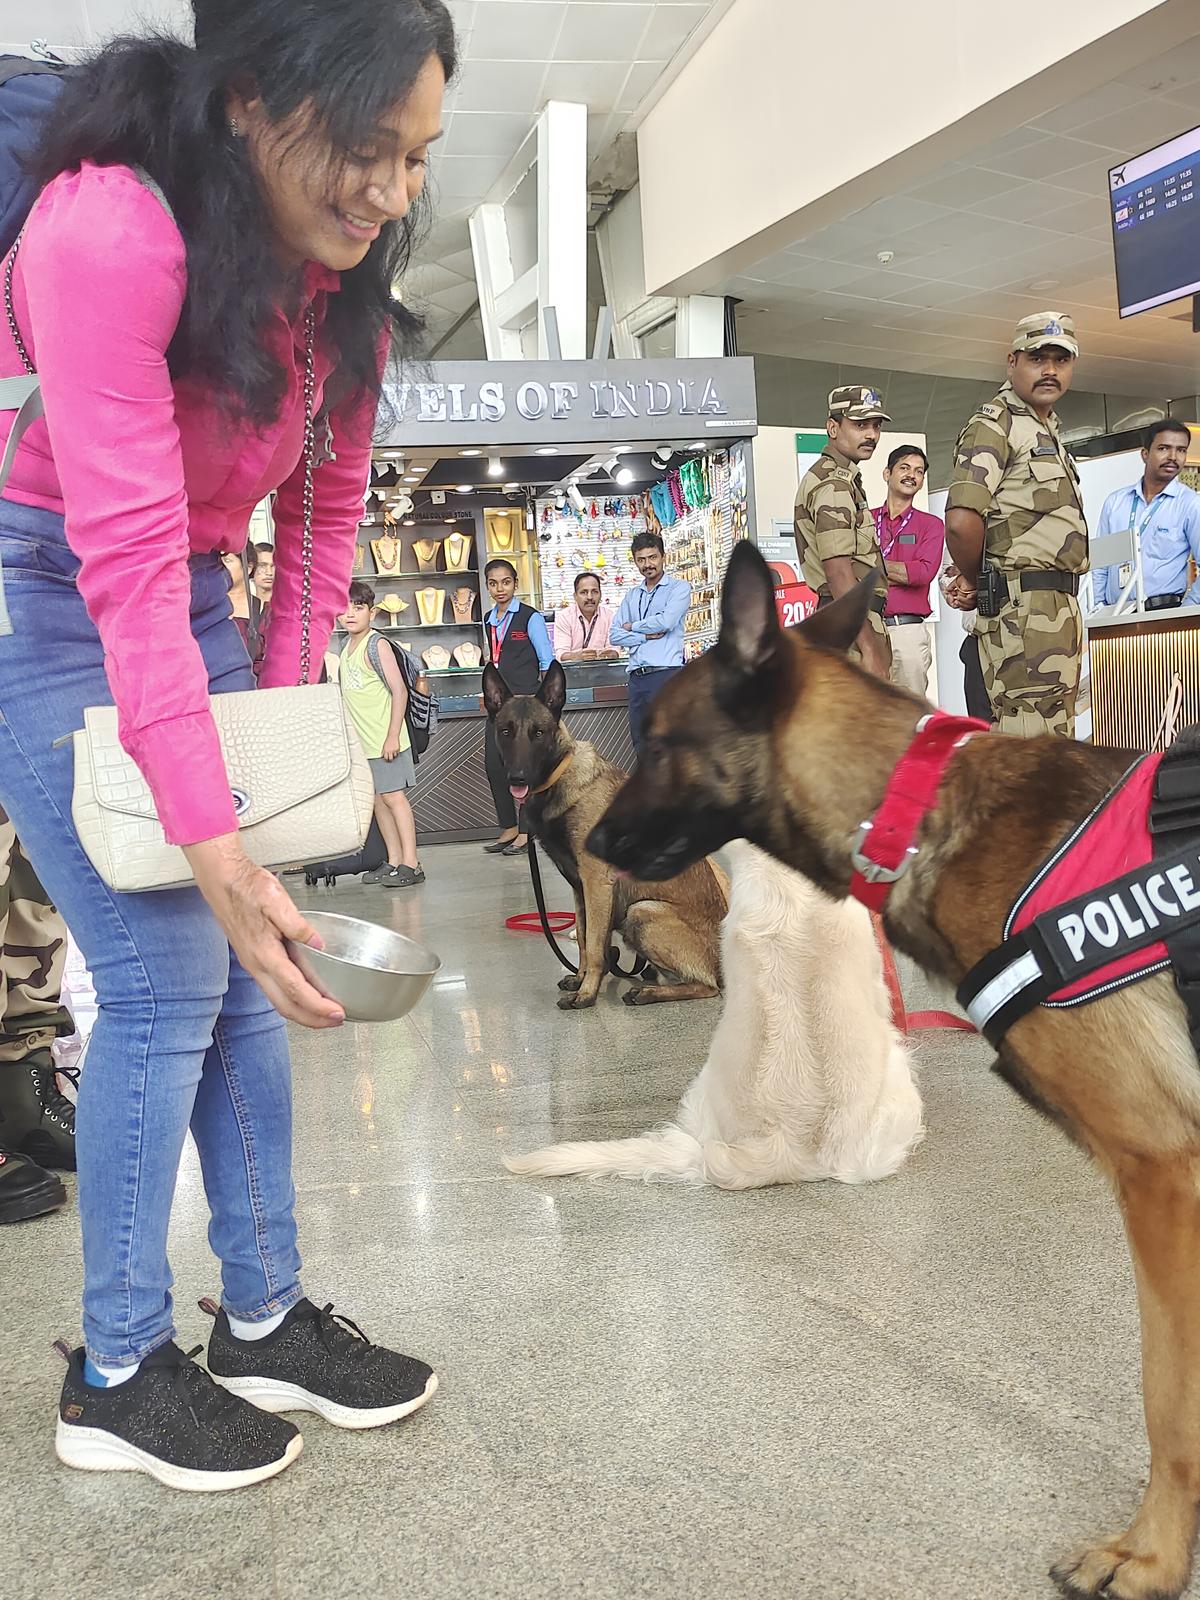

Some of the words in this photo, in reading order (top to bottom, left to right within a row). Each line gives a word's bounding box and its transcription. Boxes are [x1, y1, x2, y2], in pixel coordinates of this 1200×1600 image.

[516, 381, 579, 420] OF
[589, 377, 729, 418] INDIA
[454, 510, 473, 518] STONE
[1058, 864, 1200, 962] POLICE
